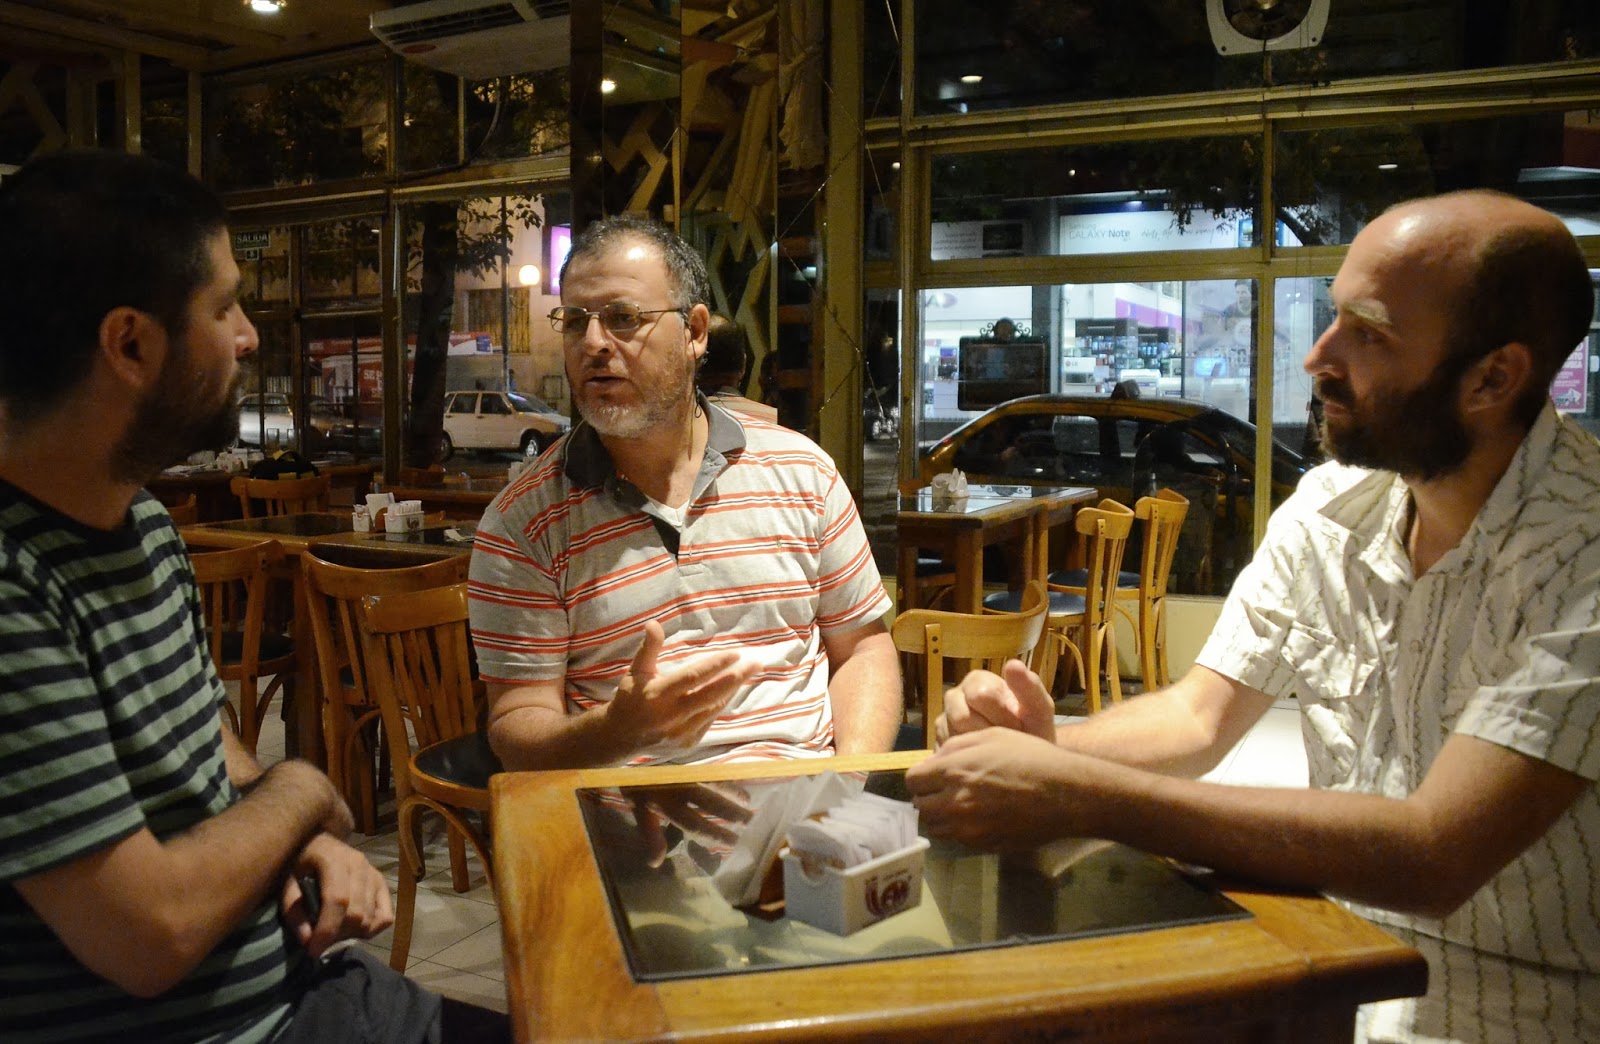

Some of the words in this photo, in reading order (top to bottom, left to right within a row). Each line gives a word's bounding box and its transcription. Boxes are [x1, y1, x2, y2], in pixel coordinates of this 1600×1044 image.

[236, 233, 268, 244] SALIDA
[1069, 229, 1106, 239] GALAXY
[1108, 229, 1131, 238] Note
